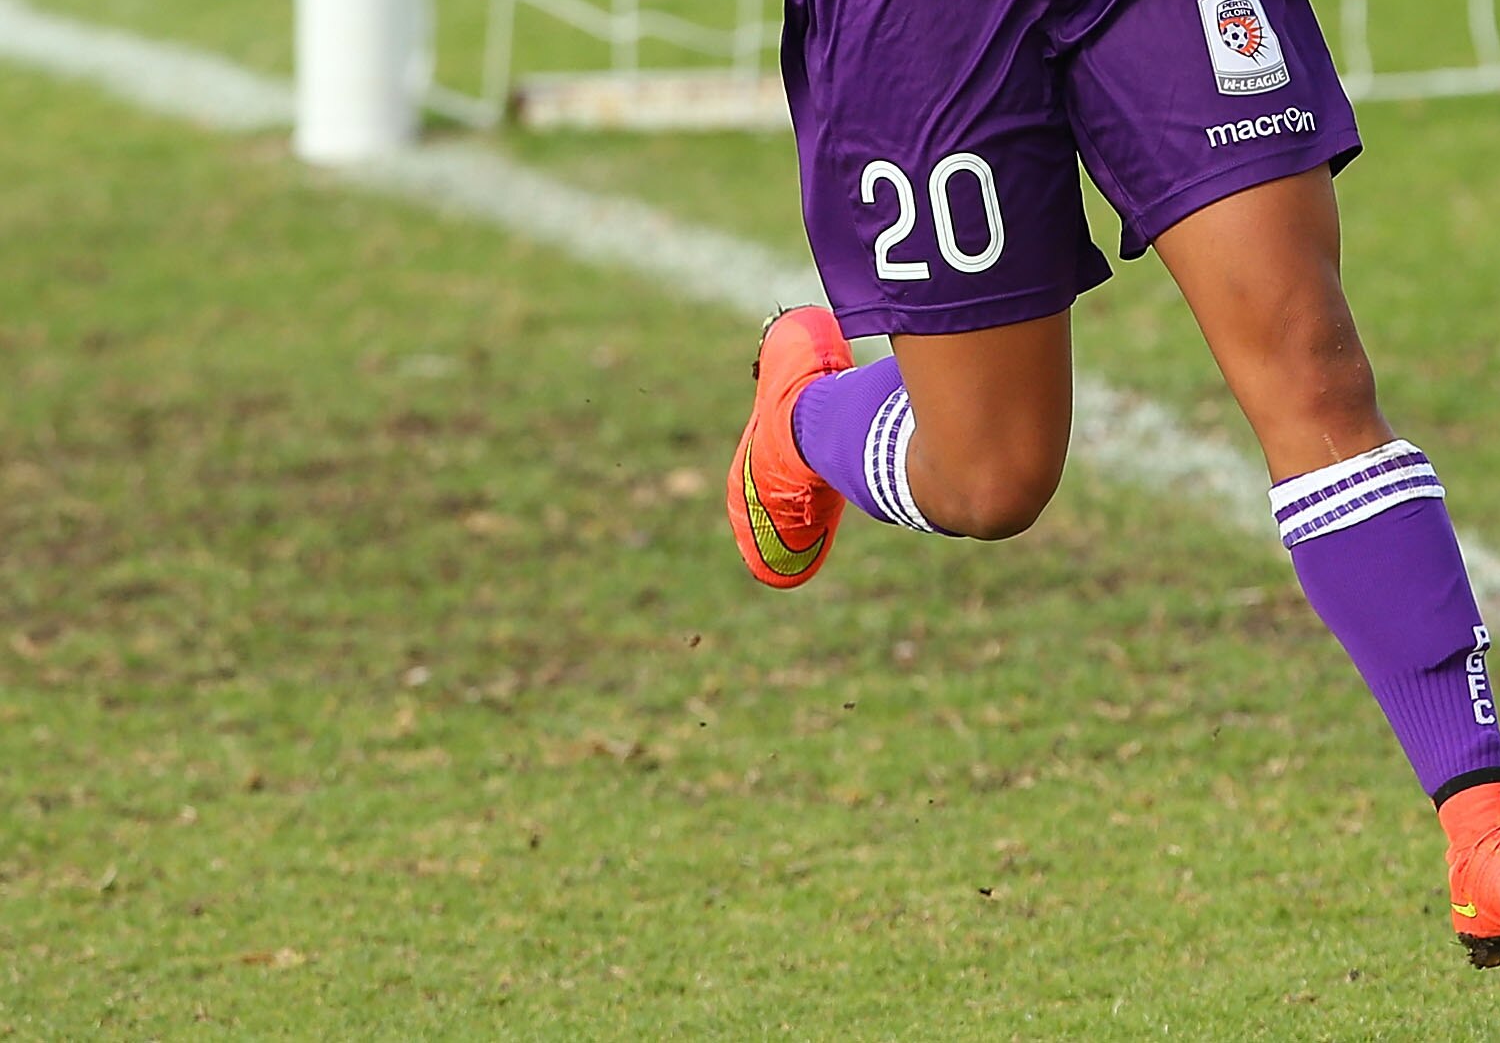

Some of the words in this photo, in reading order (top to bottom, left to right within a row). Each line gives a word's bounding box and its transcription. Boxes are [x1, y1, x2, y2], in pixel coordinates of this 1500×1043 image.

[1221, 8, 1251, 19] GLORY
[1222, 0, 1249, 10] PERTH
[1223, 69, 1286, 91] W-LEAGUE
[1205, 107, 1316, 147] macron
[861, 152, 1005, 279] 20
[1466, 624, 1496, 725] PGFC
